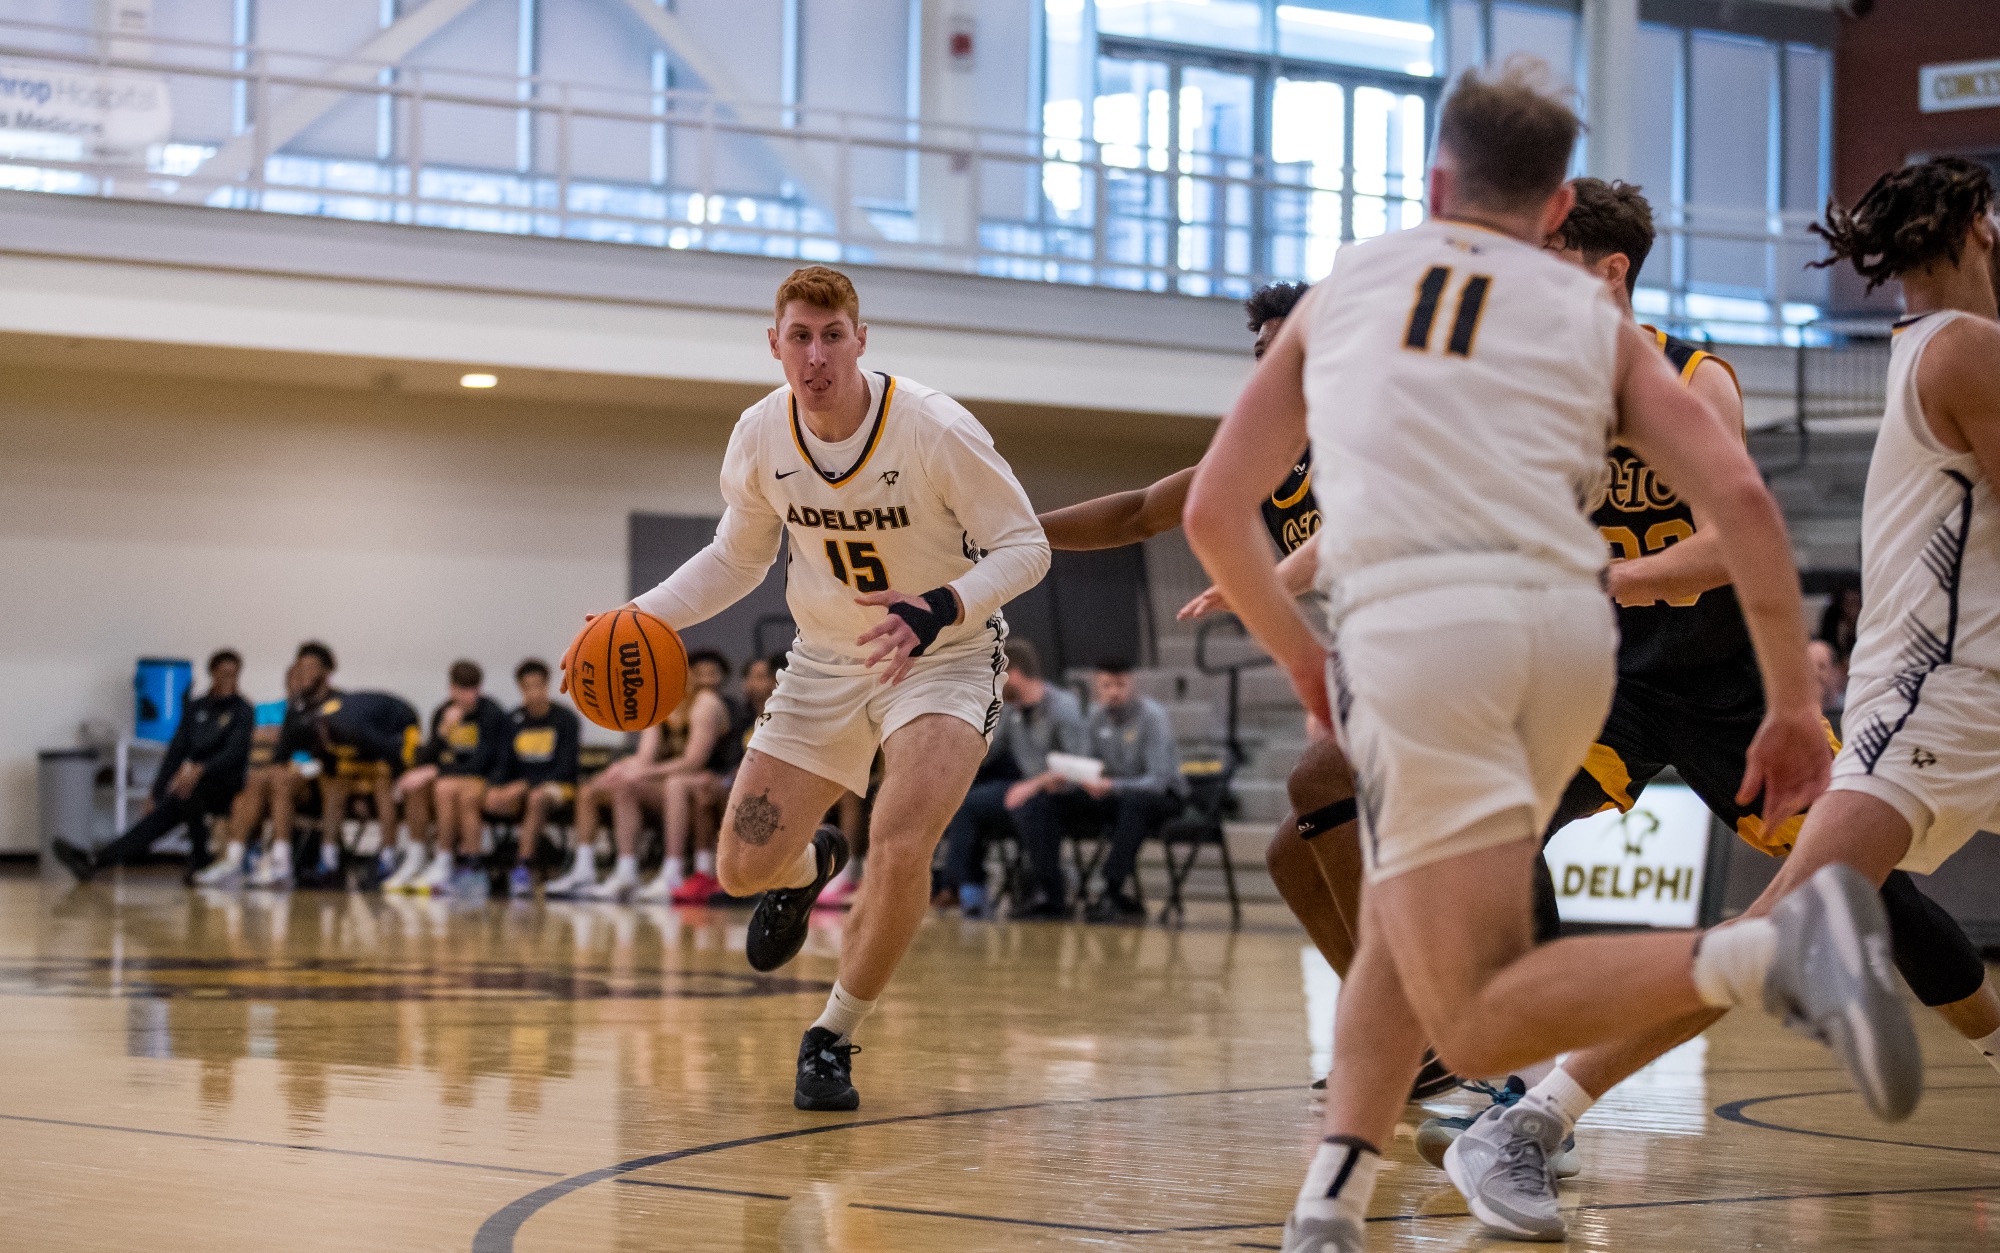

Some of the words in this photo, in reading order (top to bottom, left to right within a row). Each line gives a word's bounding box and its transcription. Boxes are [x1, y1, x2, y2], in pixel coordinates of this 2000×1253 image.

[1402, 262, 1492, 359] 11
[786, 502, 911, 532] ADELPHI
[823, 538, 891, 593] 15
[618, 641, 644, 721] Wilson
[1551, 864, 1693, 901] DELPHI
